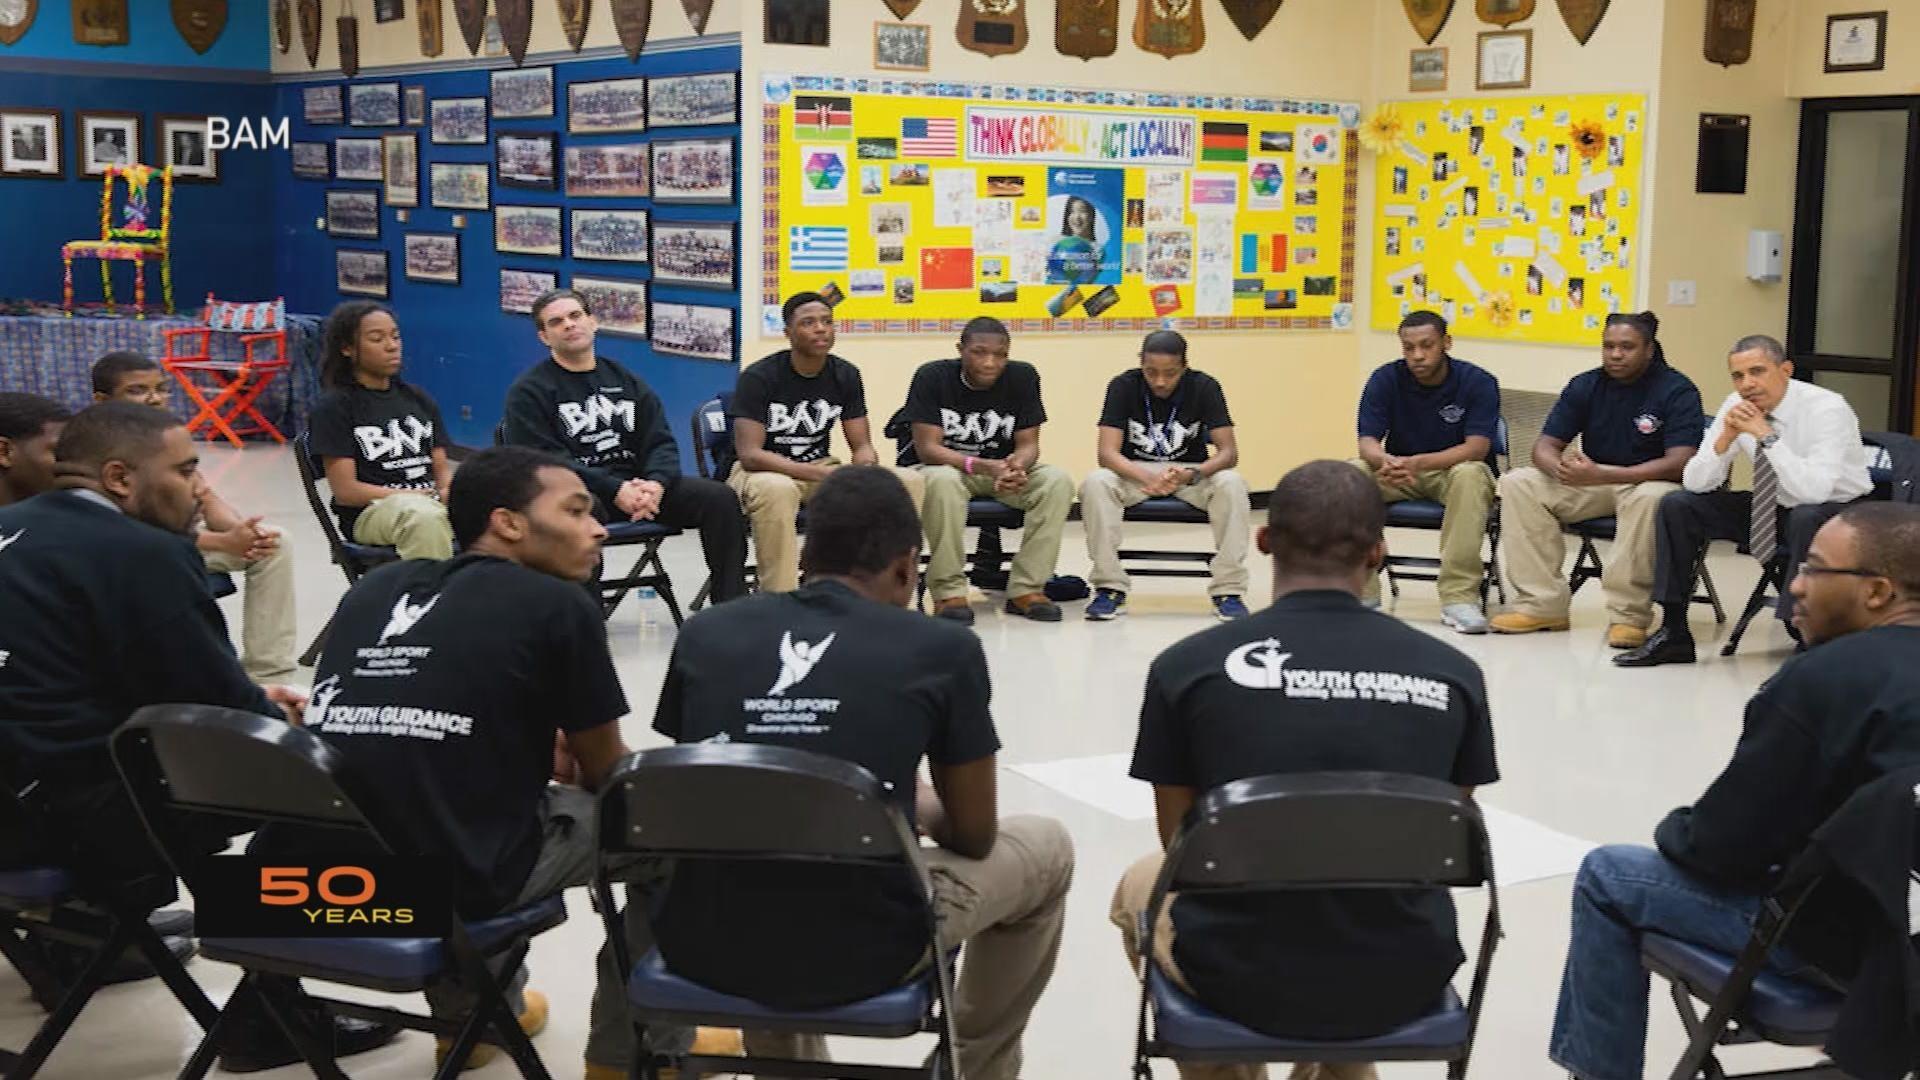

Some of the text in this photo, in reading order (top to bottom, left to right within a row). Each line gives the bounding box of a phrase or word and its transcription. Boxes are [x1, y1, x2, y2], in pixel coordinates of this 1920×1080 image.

[970, 115, 1016, 154] THINK
[1019, 115, 1090, 155] GLOBALLY
[1101, 122, 1127, 159] ACT
[1129, 120, 1192, 159] LOCALLY!
[557, 394, 636, 438] BAM
[766, 399, 843, 434] BAM
[940, 407, 1016, 442] BAM
[353, 415, 434, 461] BAM
[1128, 418, 1202, 454] BAM
[356, 646, 433, 658] WORLD SPORT
[1283, 669, 1351, 689] YOUTH
[1353, 671, 1449, 700] GUIDANCE
[326, 705, 380, 724] YOUTH
[380, 706, 474, 736] GUIDANCE
[743, 698, 840, 713] WORLD SPORT
